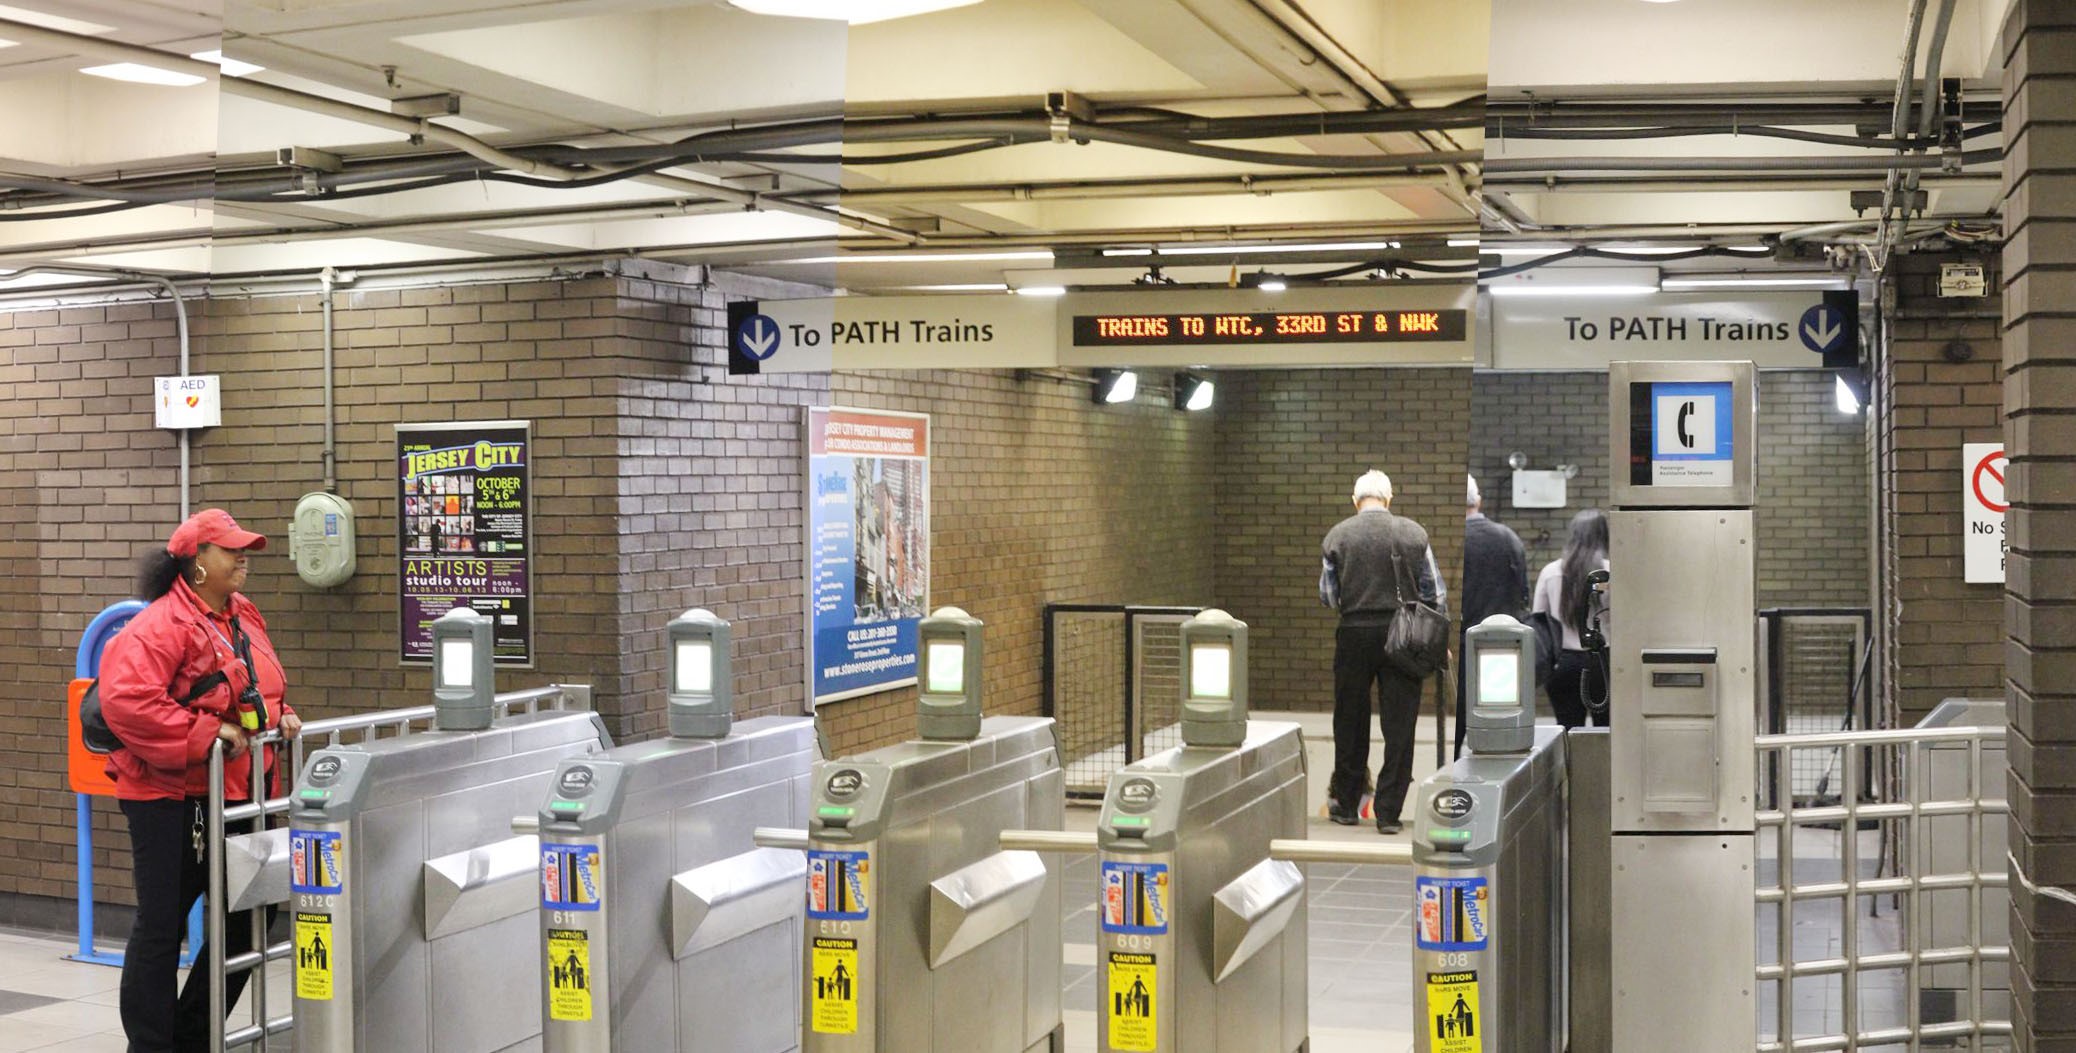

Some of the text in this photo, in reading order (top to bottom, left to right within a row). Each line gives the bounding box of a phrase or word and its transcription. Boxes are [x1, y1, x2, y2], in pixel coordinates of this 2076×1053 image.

[1097, 312, 1440, 337] TRAINS TO WTC, 33RD ST & NWK
[1564, 316, 1790, 341] To PATH Trains
[789, 319, 993, 347] To PATH Trains
[180, 379, 206, 390] AED
[406, 442, 520, 480] JERSEY CITY
[476, 477, 521, 490] OCTOBER
[1972, 521, 1994, 535] No
[406, 560, 487, 576] ARTISTS
[406, 575, 488, 587] studio tour
[300, 895, 334, 908] 612C
[298, 913, 328, 923] CAUTION
[553, 911, 576, 924] 611
[816, 939, 854, 949] CAUTION
[1117, 935, 1153, 949] 609
[1112, 954, 1152, 964] CAUTION
[1438, 953, 1469, 968] 608
[1430, 973, 1473, 983] CAUTION
